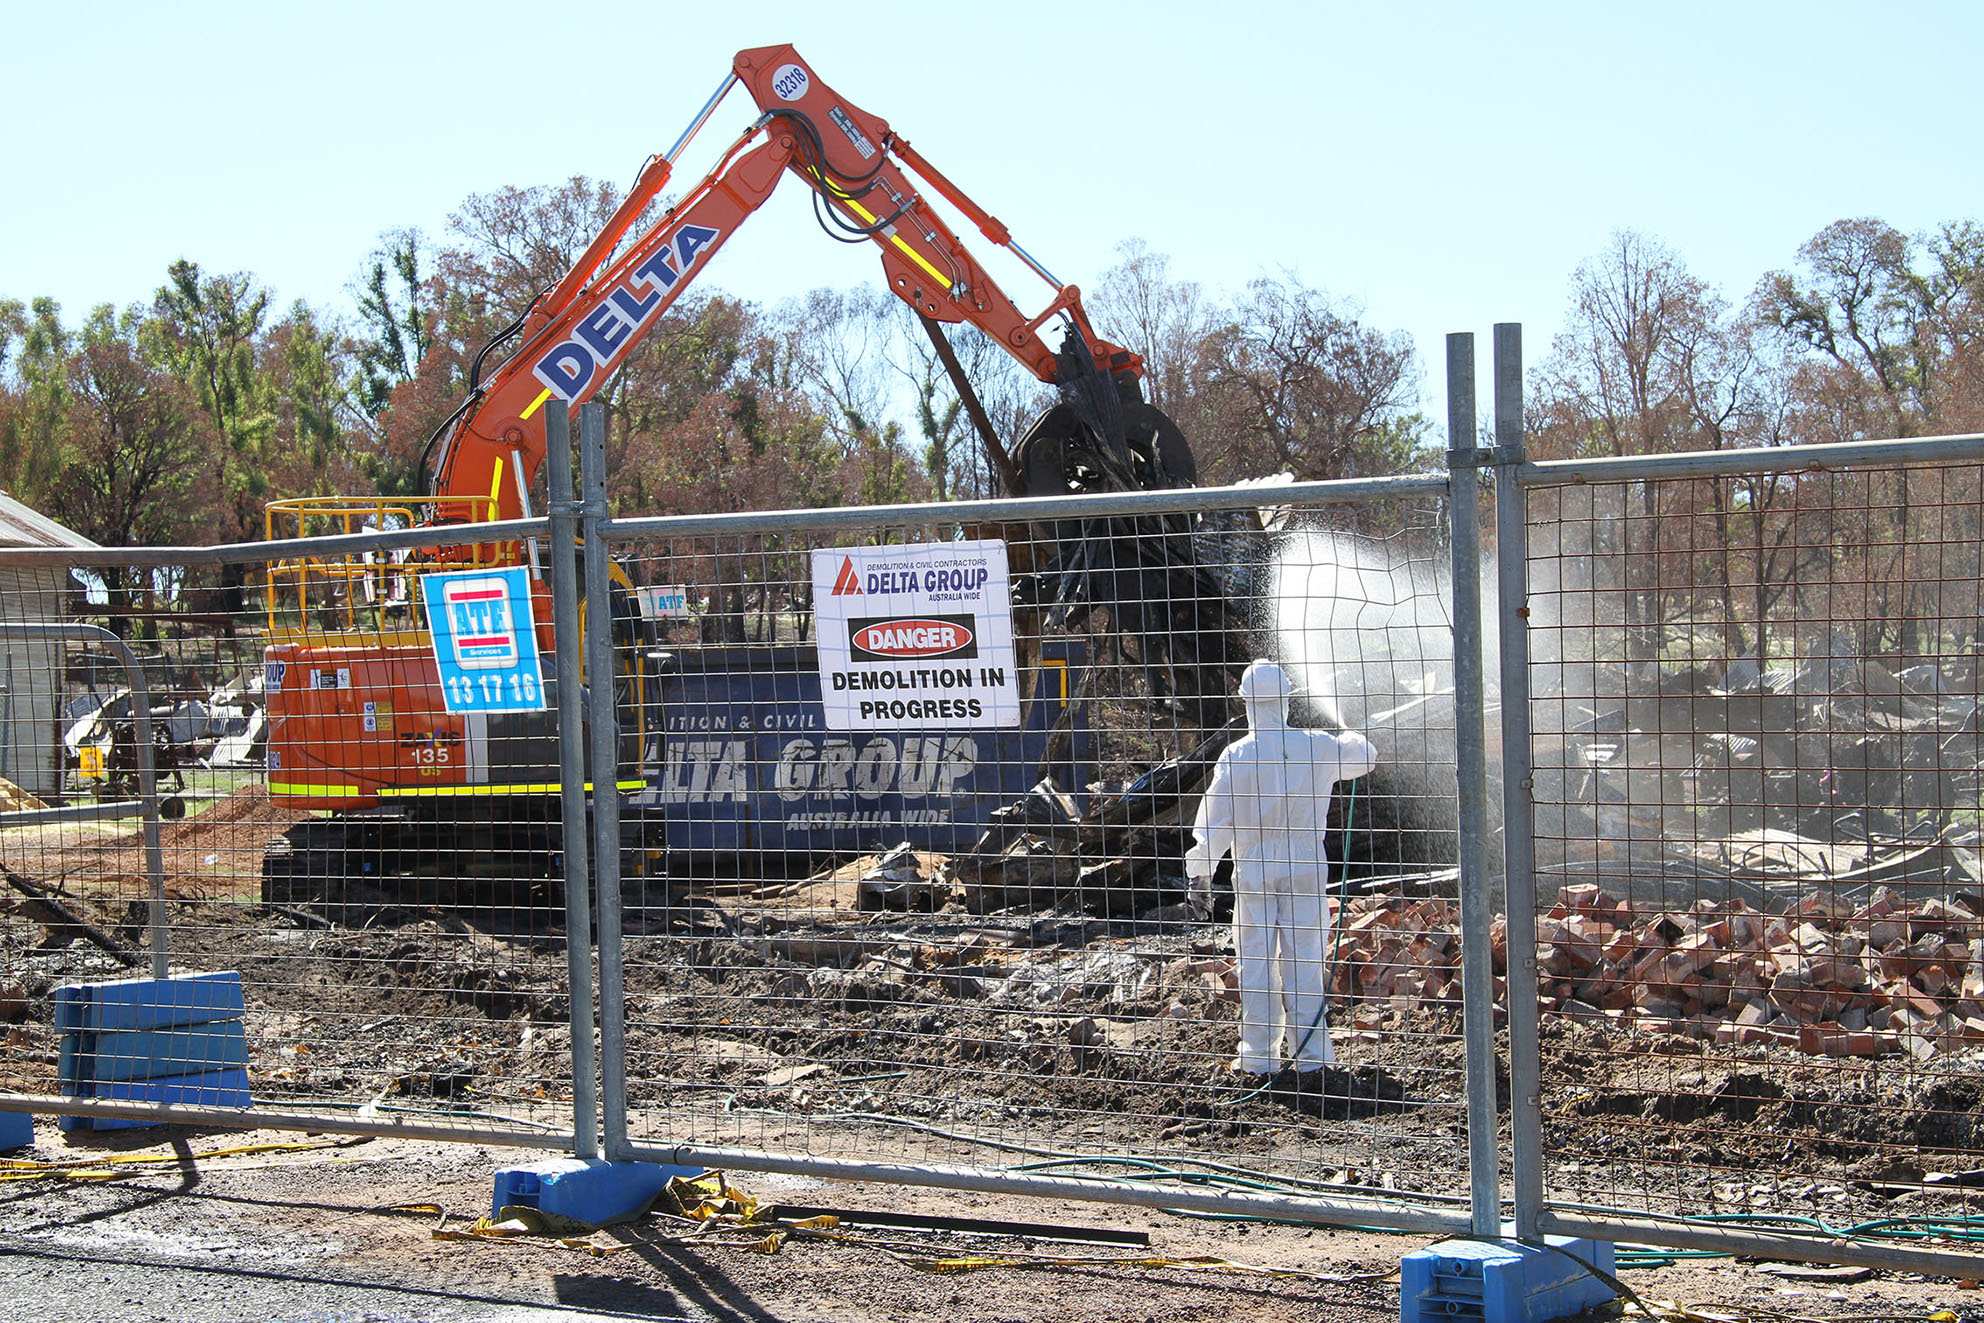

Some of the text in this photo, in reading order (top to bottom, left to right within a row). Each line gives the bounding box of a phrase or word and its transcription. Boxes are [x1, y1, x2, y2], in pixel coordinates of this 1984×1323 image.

[775, 68, 806, 98] 32318
[533, 224, 719, 405] DELTA
[867, 562, 910, 571] DEMOLITION
[916, 561, 932, 569] CIVIL
[934, 559, 987, 568] CONTRACTORS
[867, 568, 988, 595] DELTA GROUP
[928, 592, 981, 602] AUSTRALIA WIDE
[868, 627, 957, 650] DANGER
[448, 673, 536, 704] 13 17 16
[832, 668, 1005, 691] DEMOLITION IN
[860, 698, 982, 720] PROGRESS
[739, 715, 750, 729] &
[763, 714, 816, 729] CIVIL
[411, 748, 449, 764] 135
[774, 737, 978, 802] GROUP
[786, 809, 951, 831] AUSTRALIA WIDE
